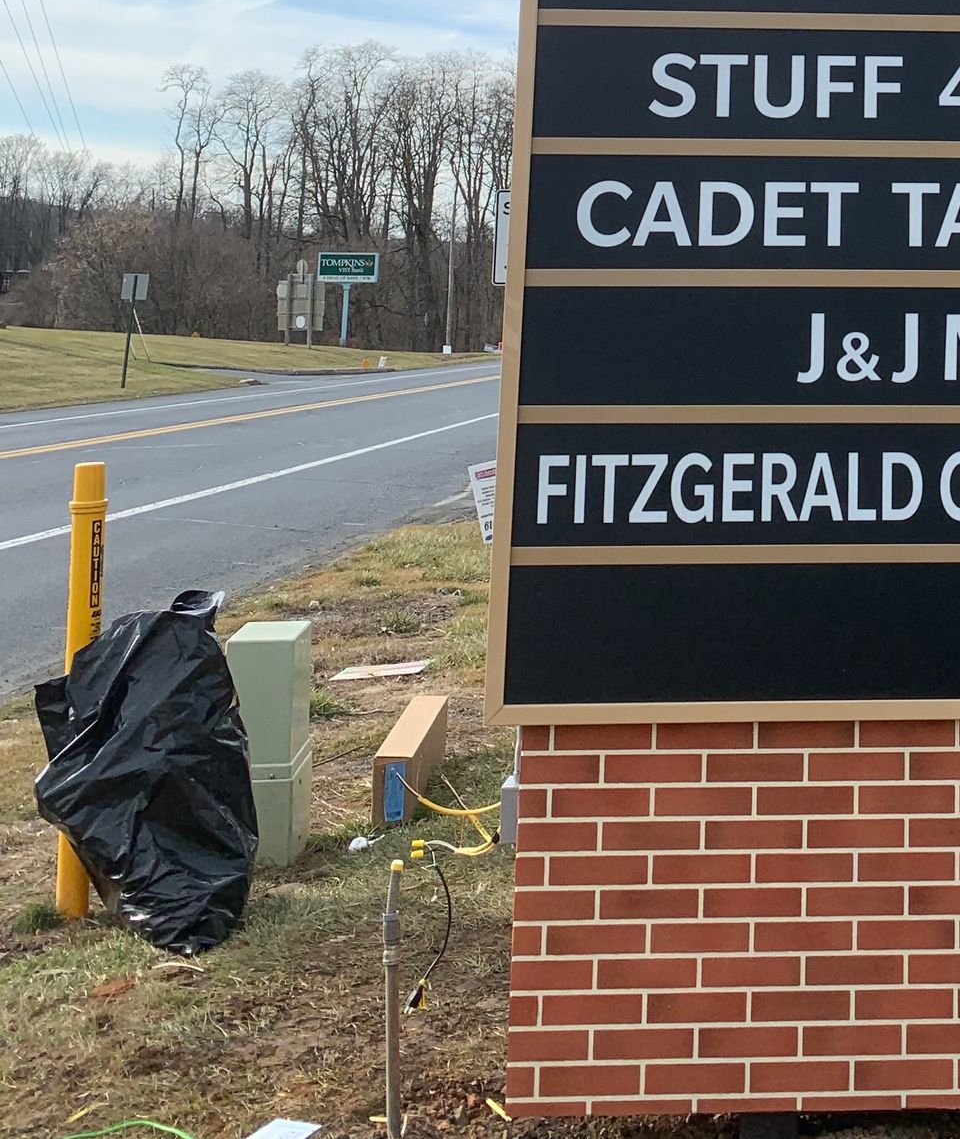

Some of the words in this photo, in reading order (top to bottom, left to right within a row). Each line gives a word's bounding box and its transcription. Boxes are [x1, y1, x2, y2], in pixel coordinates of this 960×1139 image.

[648, 53, 904, 119] STUFF
[576, 180, 860, 247] CADET
[321, 259, 365, 268] TOMPKINS
[796, 313, 919, 384] J&J
[536, 452, 923, 524] FITZGERALD
[90, 521, 102, 607] CAUTION
